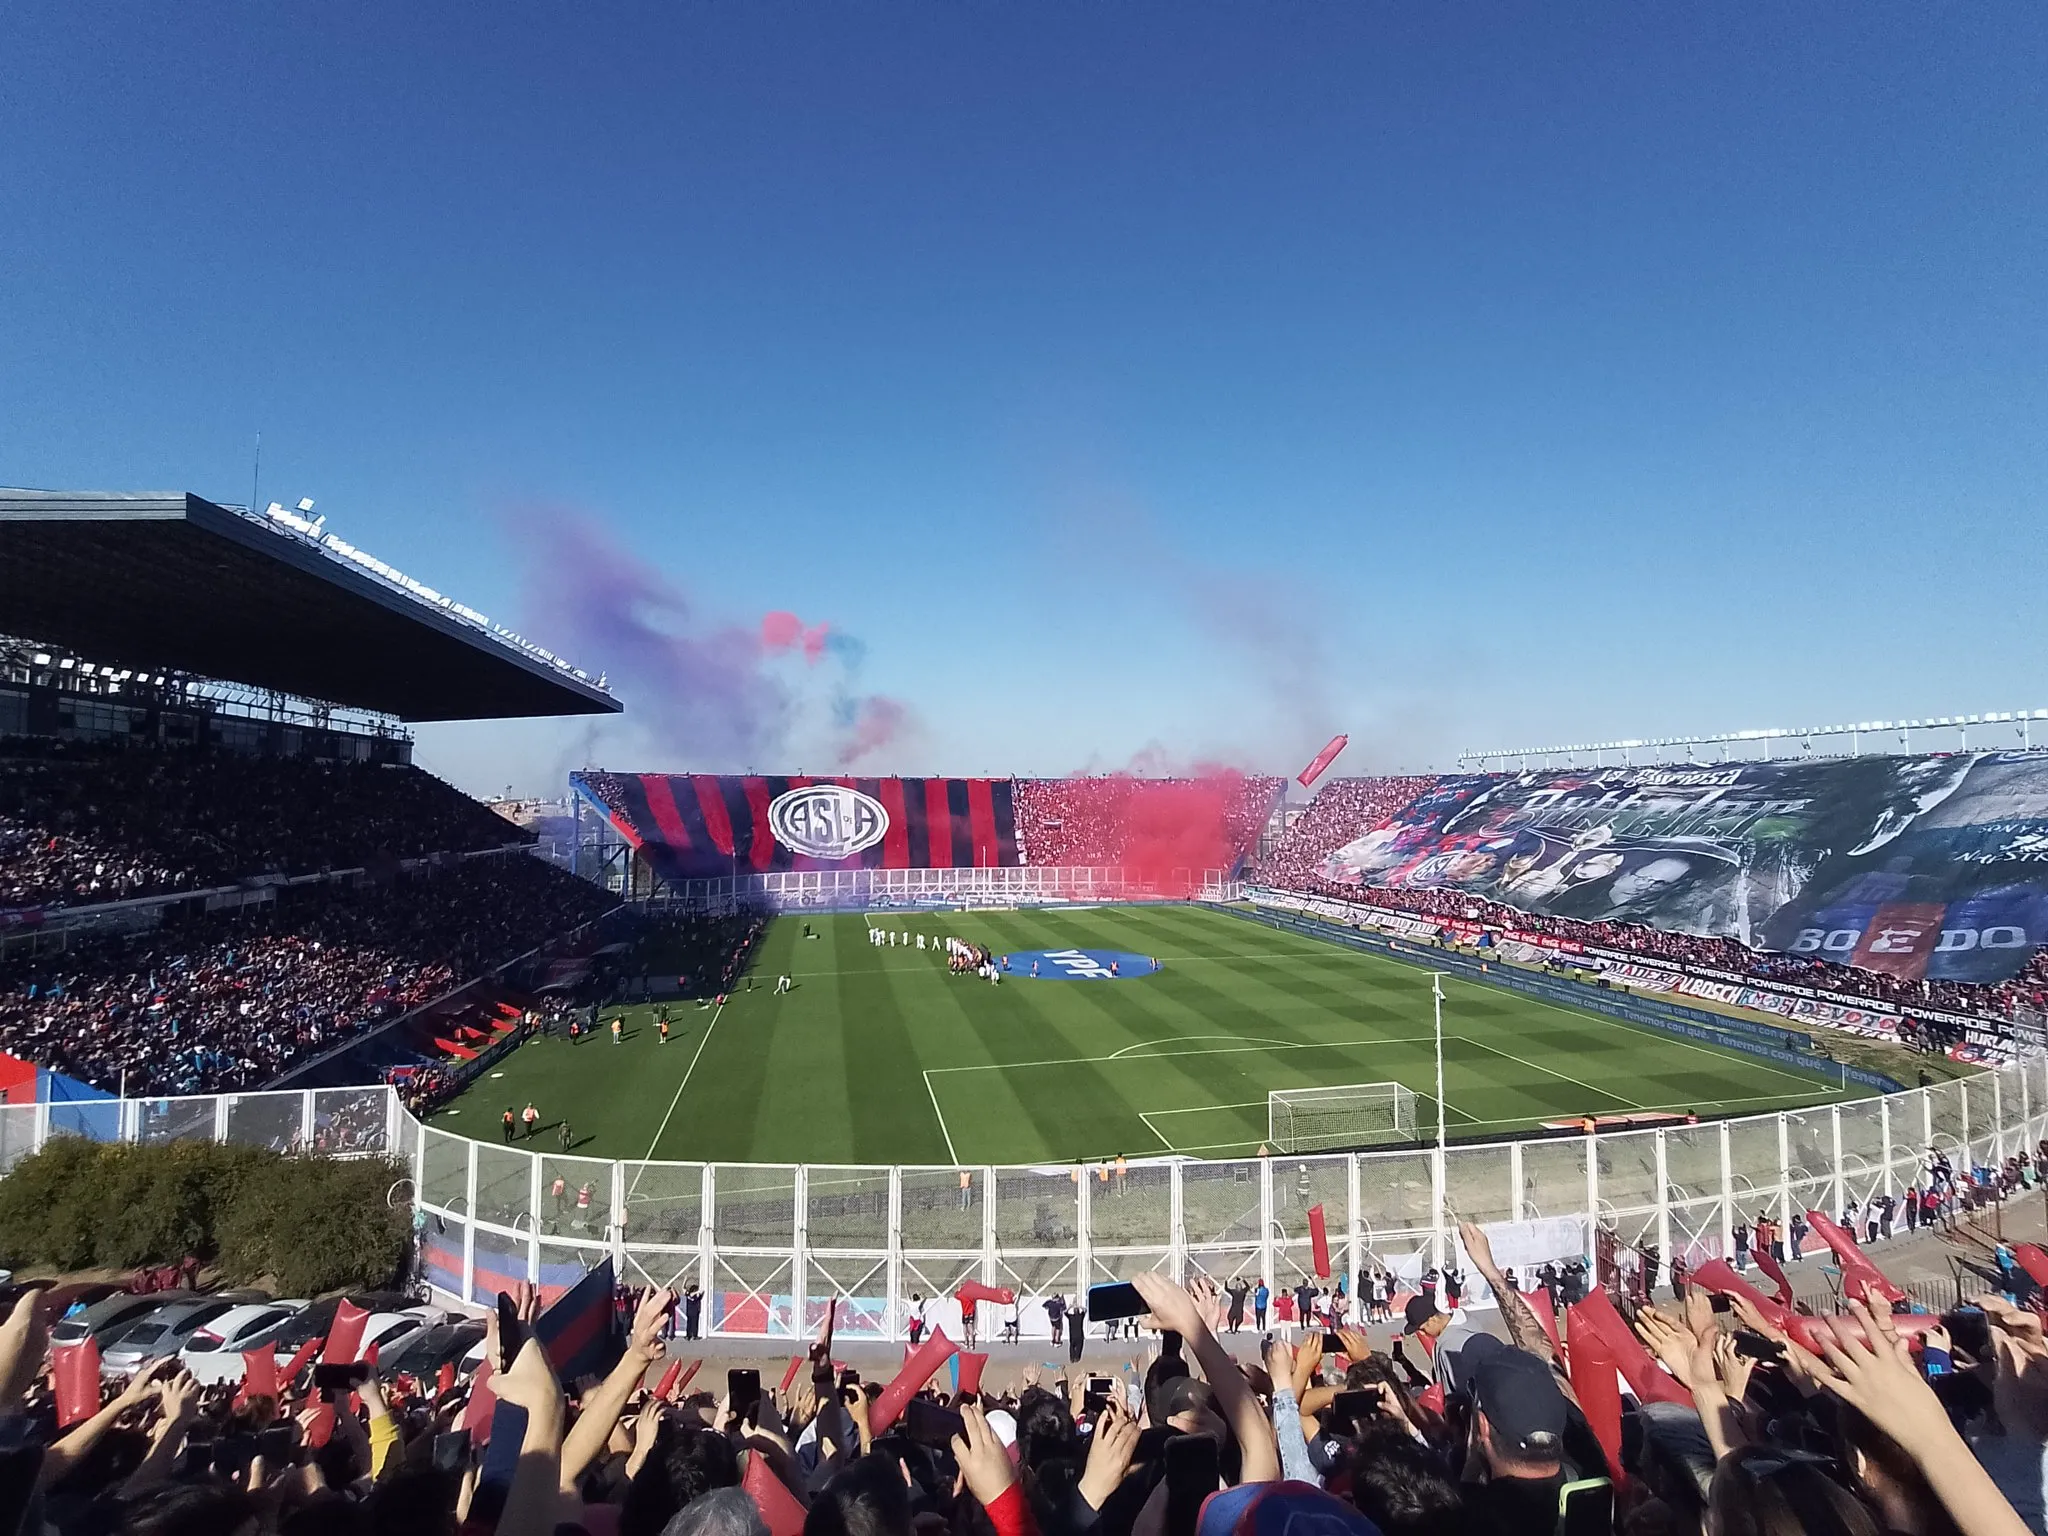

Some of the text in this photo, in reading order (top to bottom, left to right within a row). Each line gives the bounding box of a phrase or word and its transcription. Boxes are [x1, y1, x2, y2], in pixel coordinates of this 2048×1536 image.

[1790, 926, 2027, 954] BOEDO
[1043, 949, 1117, 979] YPF
[1630, 955, 1683, 972] POWERADE
[1685, 965, 1745, 984] POWERADE
[1747, 977, 1816, 999] POWERADE
[1817, 989, 1898, 1014] POWERADE
[1900, 1006, 1994, 1032] POWERADE
[1623, 1009, 1666, 1028] Tenemos
[1667, 1021, 1685, 1033] con
[1716, 1033, 1768, 1055] Tenemos
[1770, 1049, 1794, 1062] con
[1758, 1026, 1777, 1037] con
